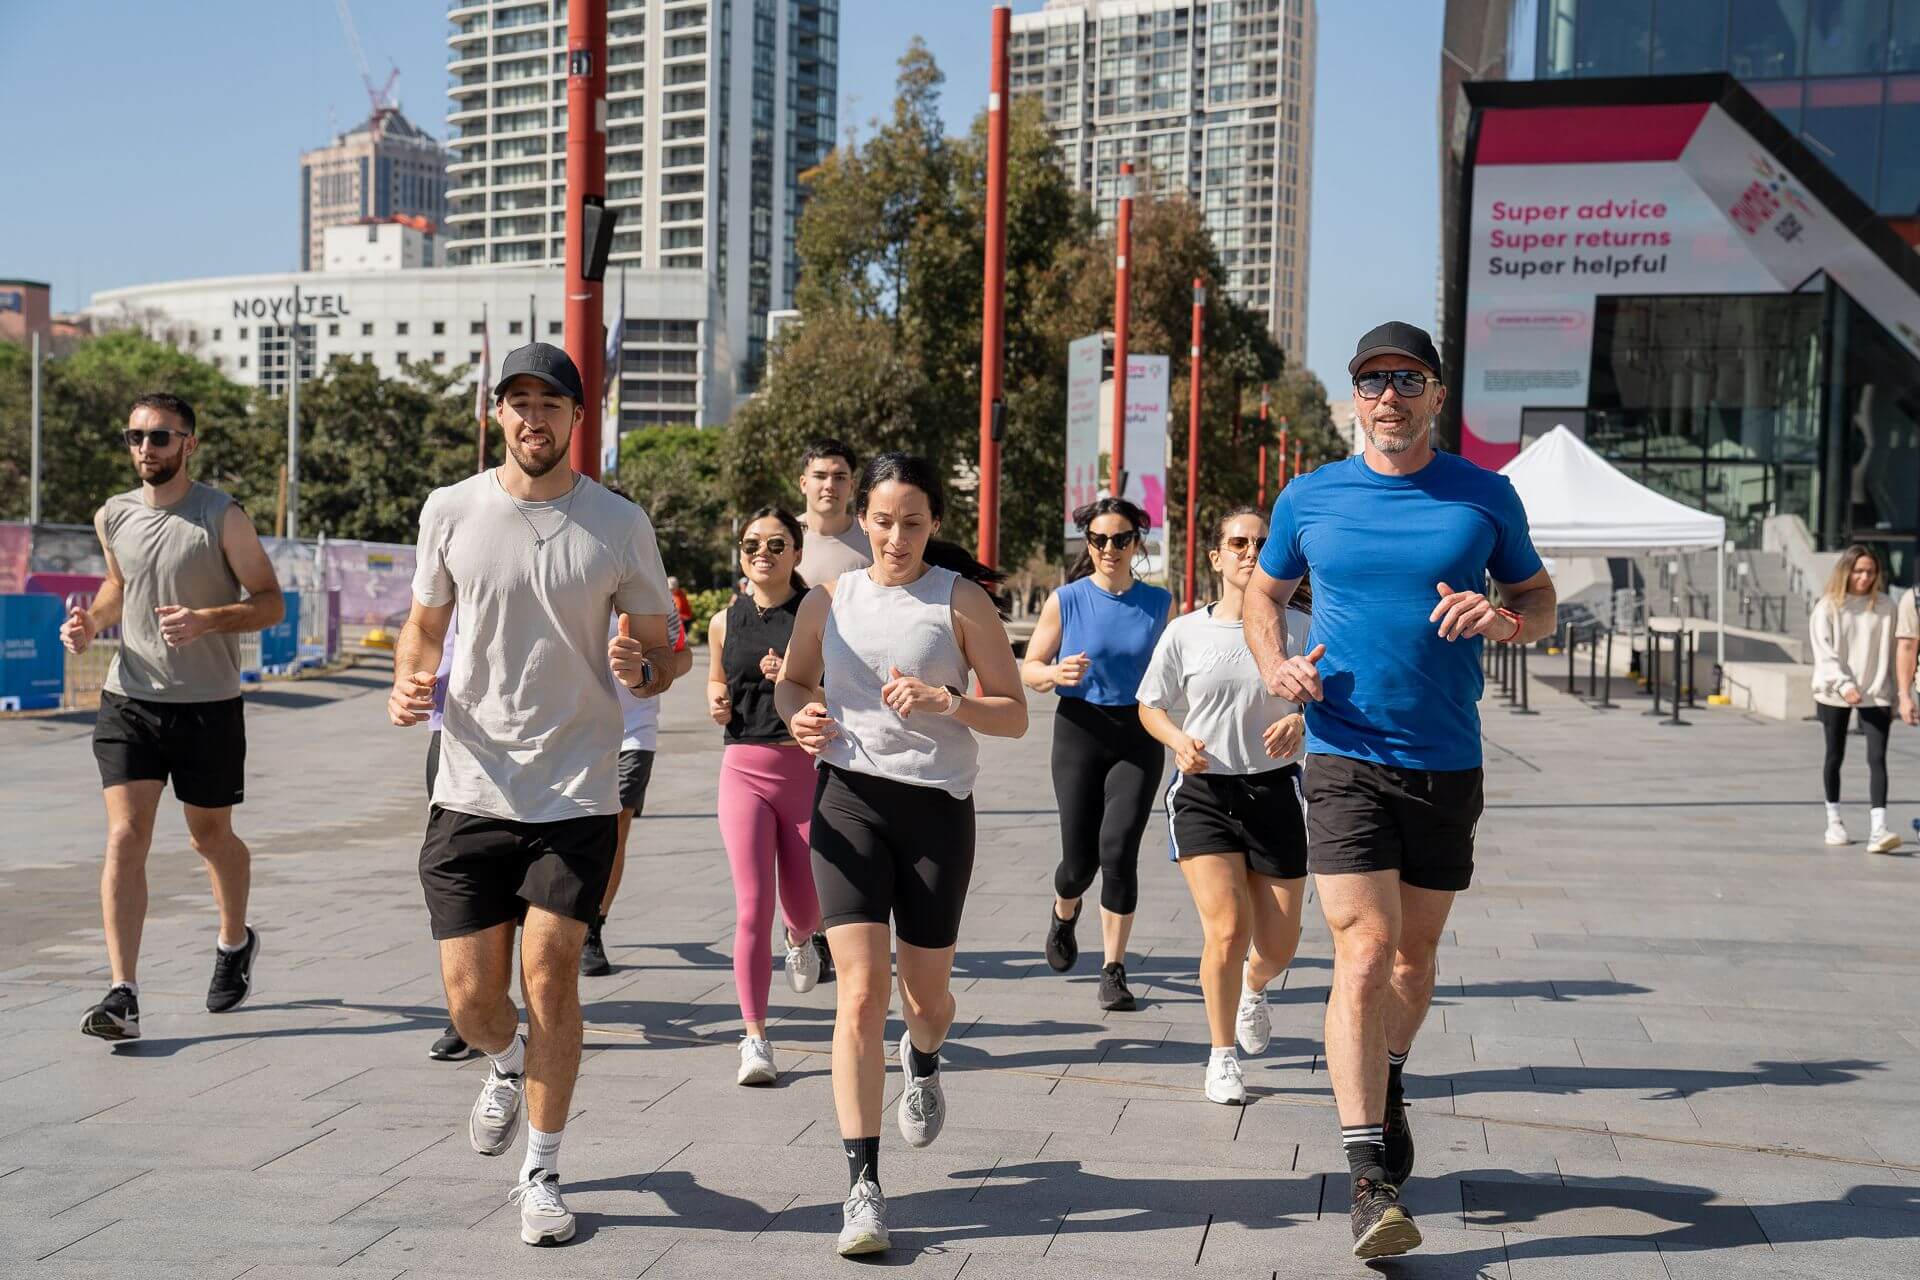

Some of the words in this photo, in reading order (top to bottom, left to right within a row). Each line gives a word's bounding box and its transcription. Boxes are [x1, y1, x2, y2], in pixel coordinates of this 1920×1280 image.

[1491, 201, 1570, 225] Super
[1577, 199, 1668, 219] advice
[1489, 229, 1567, 253] Super
[1575, 229, 1671, 247] returns
[1488, 257, 1566, 280] Super
[1572, 253, 1667, 279] helpful
[232, 295, 350, 321] NOVOTEL
